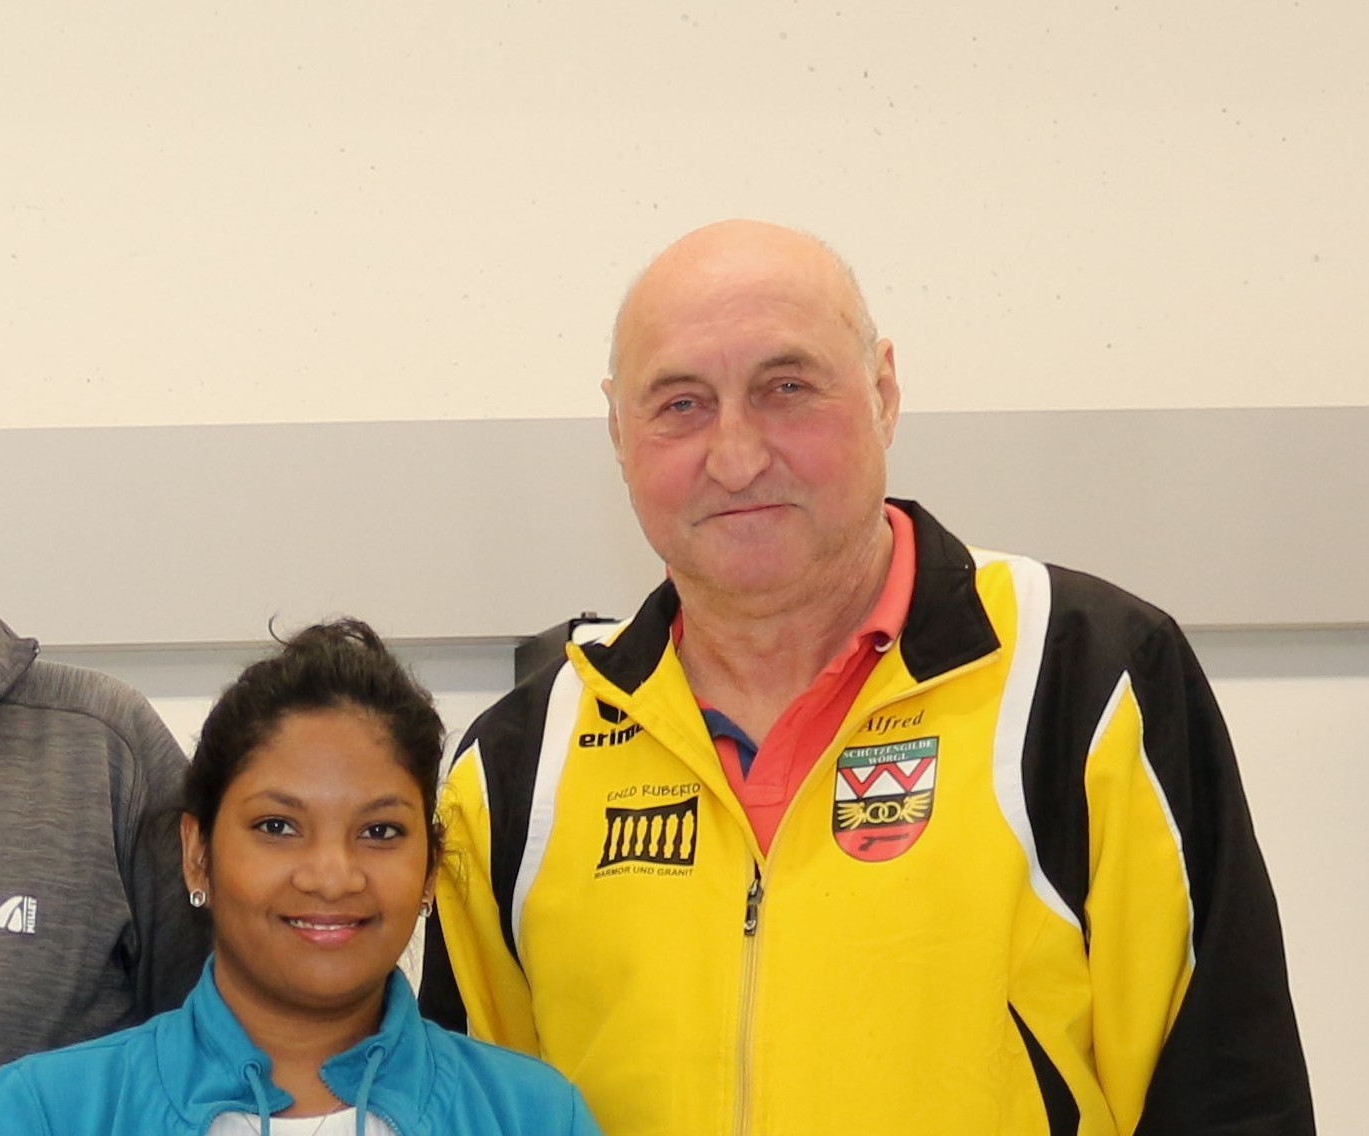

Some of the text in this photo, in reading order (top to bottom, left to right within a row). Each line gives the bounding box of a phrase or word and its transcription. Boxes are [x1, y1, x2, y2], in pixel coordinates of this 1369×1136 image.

[859, 709, 924, 736] Alfred
[842, 739, 933, 759] SCHÜTZENGILDE
[606, 782, 701, 802] ENZO RUBERTO
[594, 865, 694, 880] MARMOR UND GRANIT
